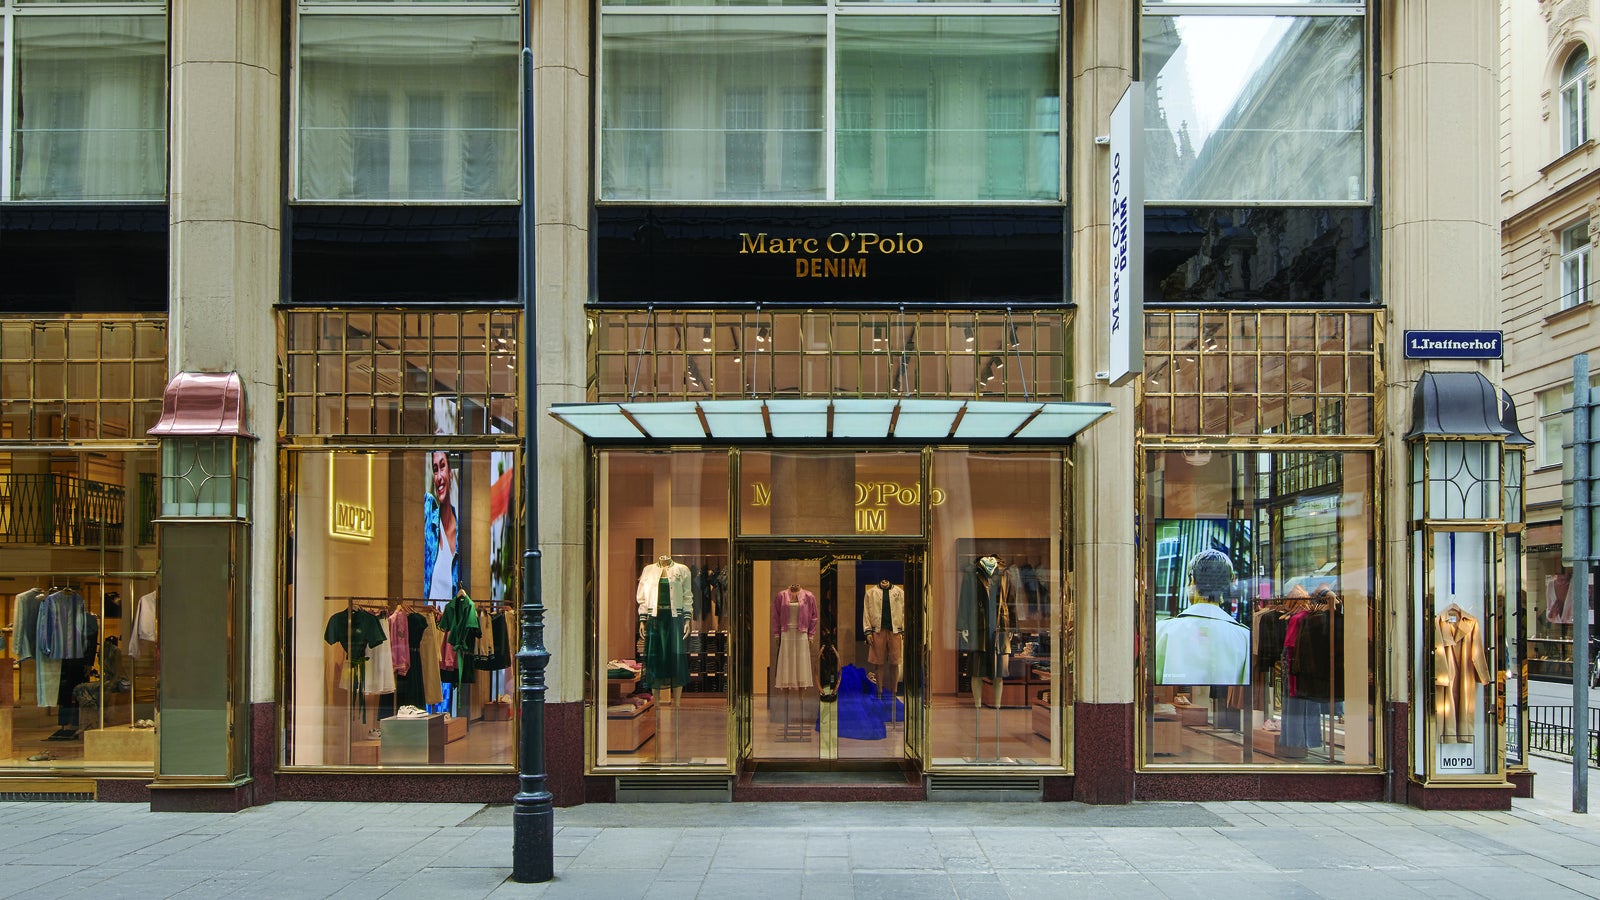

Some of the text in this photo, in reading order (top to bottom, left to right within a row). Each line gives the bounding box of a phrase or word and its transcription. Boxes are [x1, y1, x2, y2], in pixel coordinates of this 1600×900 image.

[739, 232, 924, 254] Marc O'Polo
[1112, 152, 1120, 335] Marc O'Polo
[795, 257, 867, 278] DENIM
[338, 503, 373, 531] MO'PD
[1443, 757, 1473, 767] MO'PD
